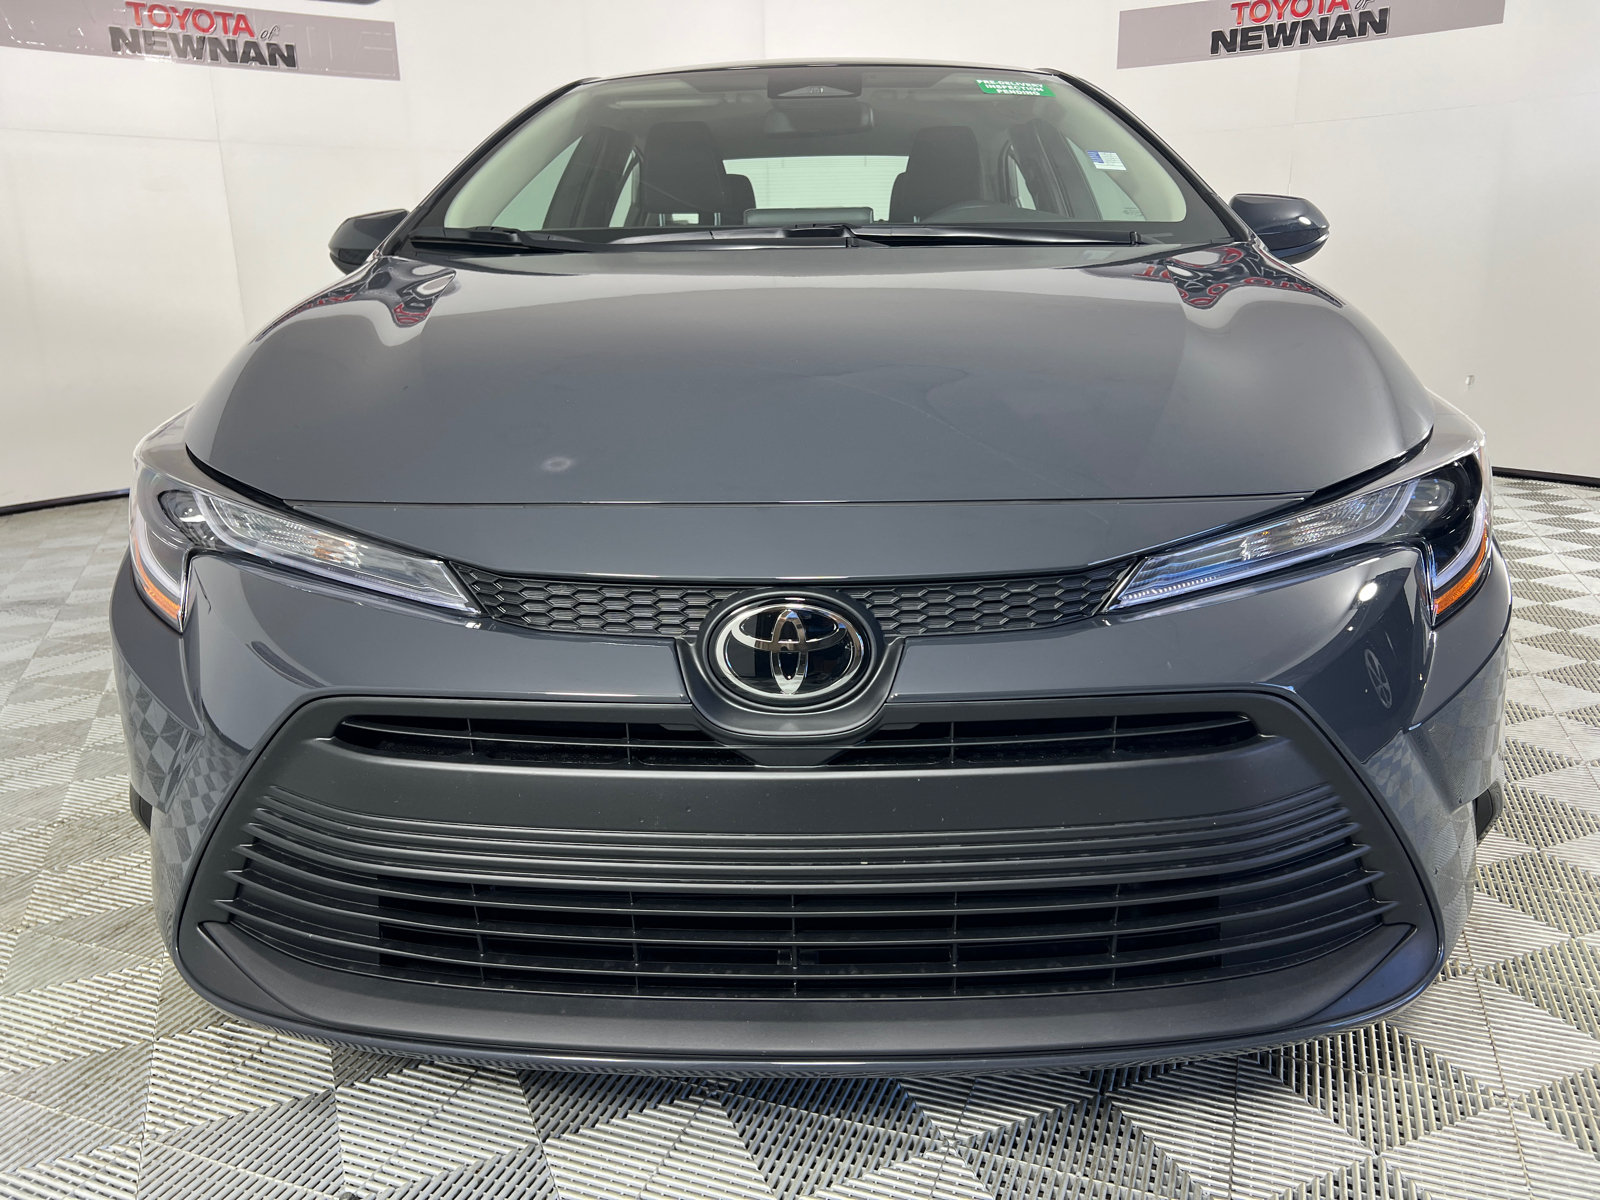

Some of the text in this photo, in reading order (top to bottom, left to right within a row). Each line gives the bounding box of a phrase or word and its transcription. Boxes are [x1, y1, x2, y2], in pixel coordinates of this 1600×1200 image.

[125, 1, 279, 41] TOYOTA of
[1210, 7, 1390, 55] NEWNAN
[108, 26, 297, 69] NEWNAN
[976, 80, 1043, 88] PRE-DELIVERY
[985, 84, 1044, 92] INSPECTION
